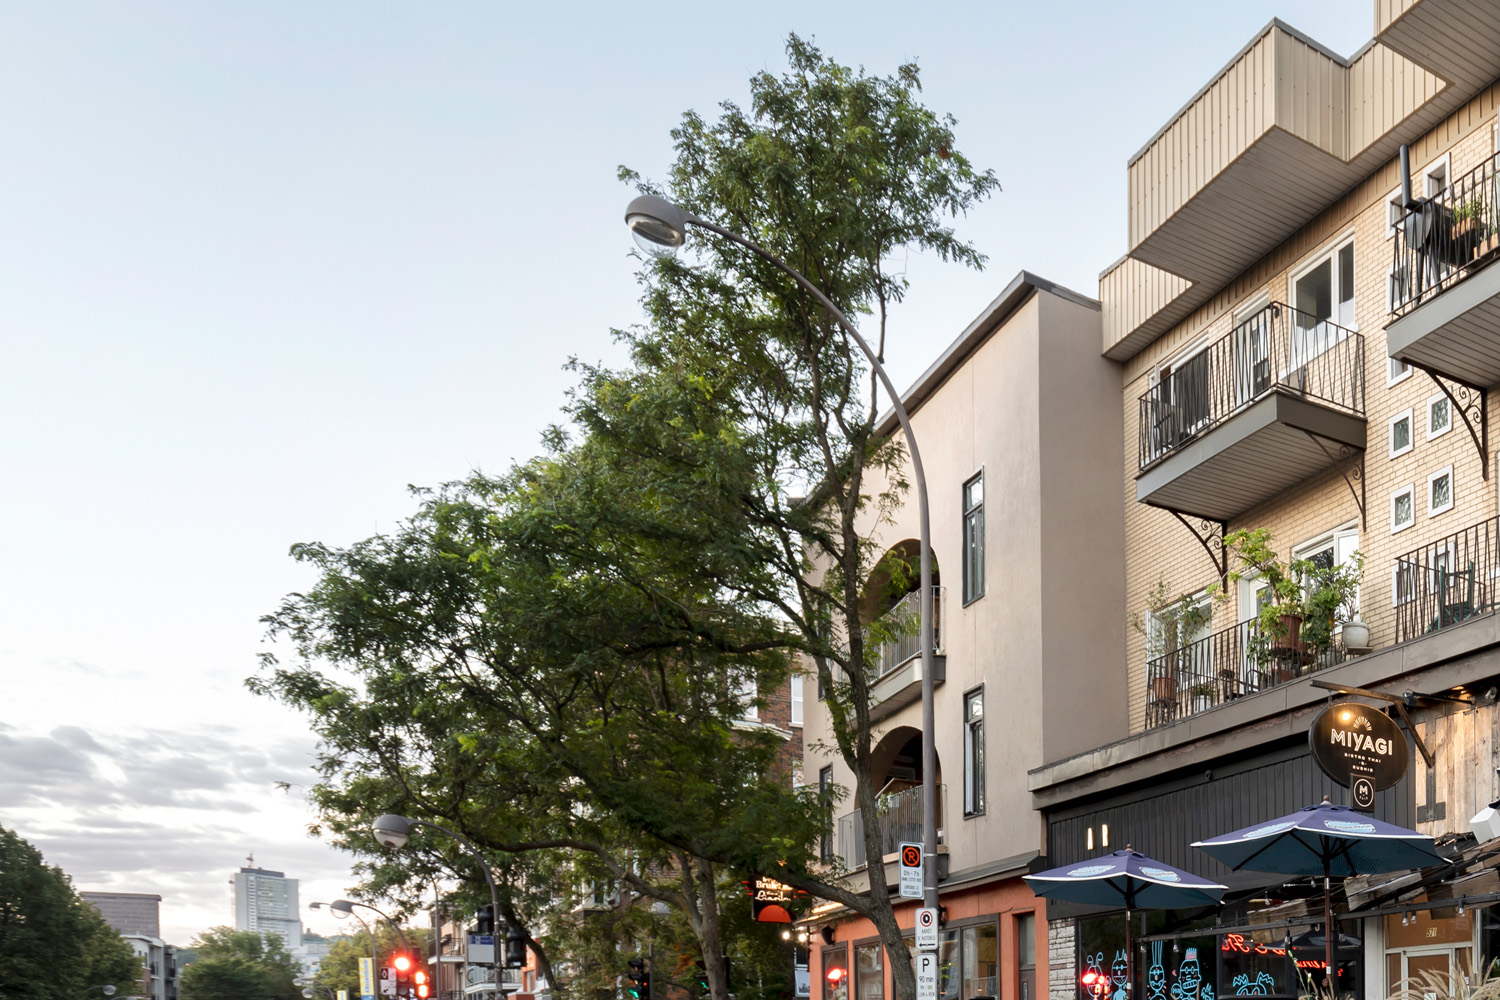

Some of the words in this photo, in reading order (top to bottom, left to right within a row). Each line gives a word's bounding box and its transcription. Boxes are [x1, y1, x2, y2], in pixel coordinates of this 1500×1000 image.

[1331, 729, 1392, 755] MIYAGI
[1344, 752, 1366, 761] BISTRO
[1359, 784, 1368, 795] M
[923, 958, 930, 973] P
